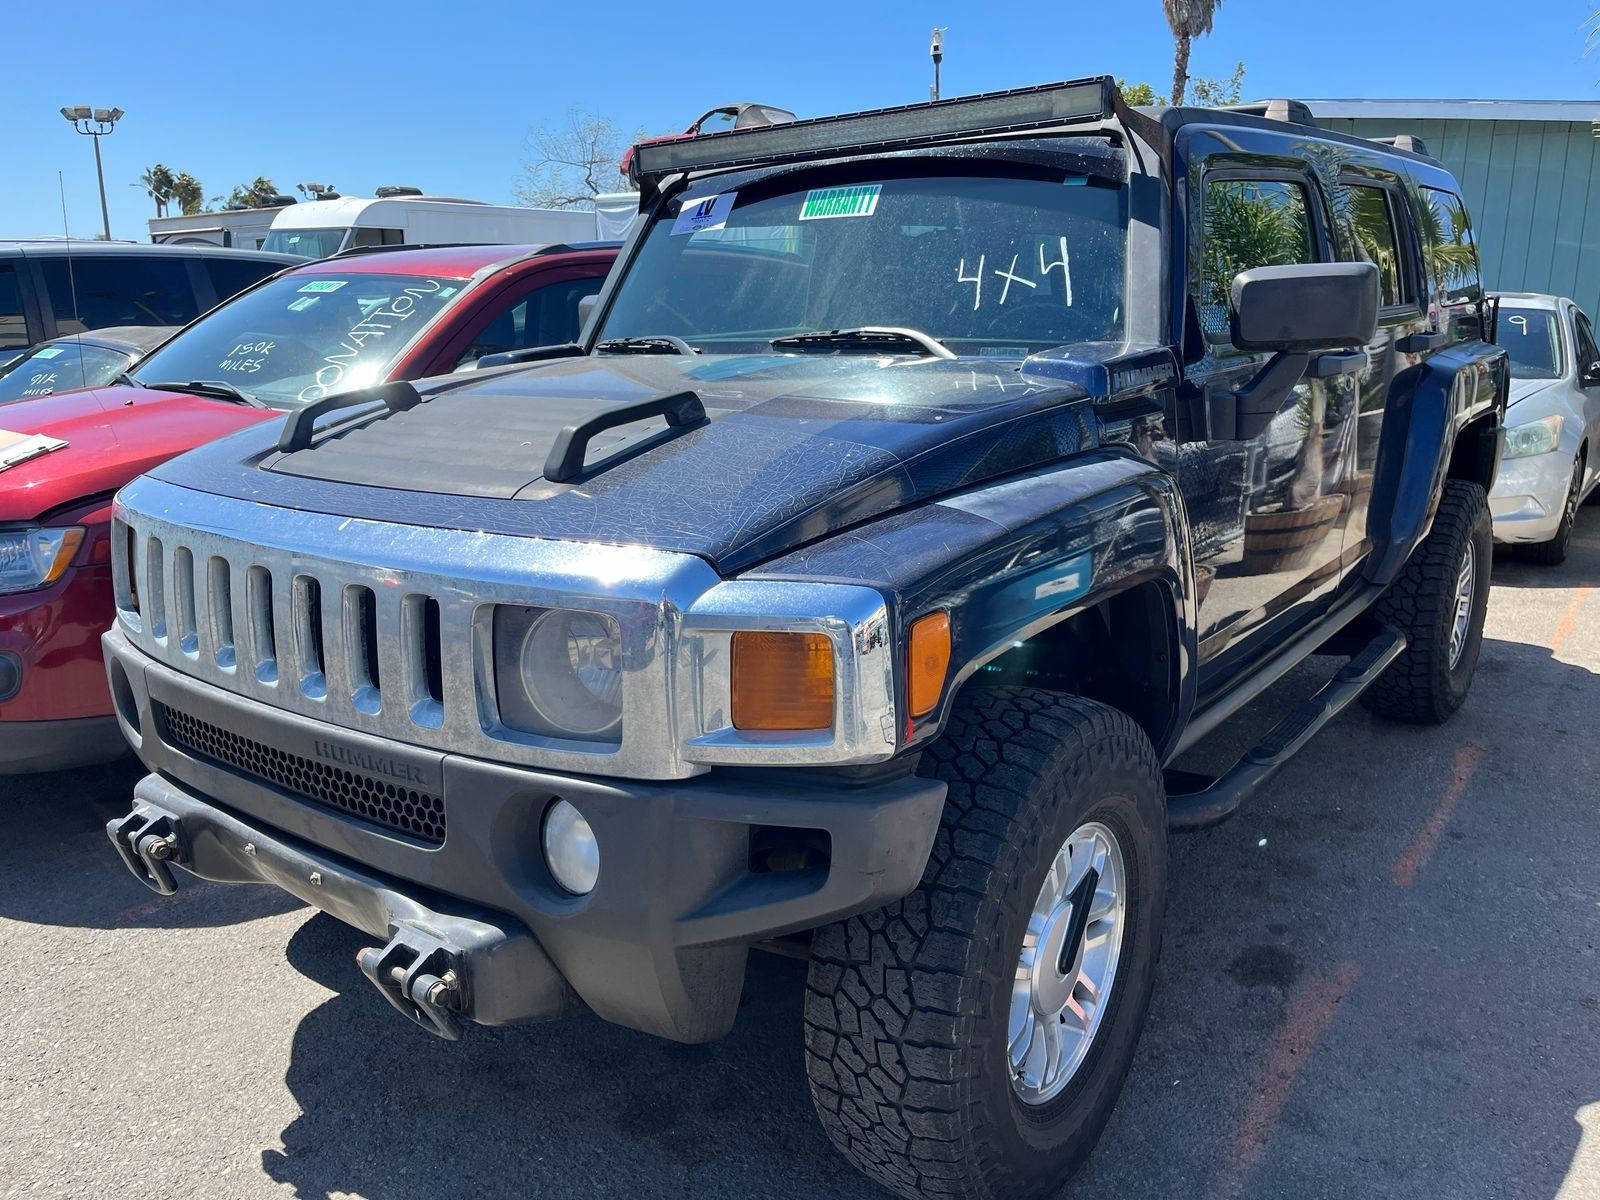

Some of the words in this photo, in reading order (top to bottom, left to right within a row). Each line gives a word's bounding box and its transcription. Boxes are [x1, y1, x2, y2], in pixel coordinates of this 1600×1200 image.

[803, 186, 879, 218] WARRANTY
[1508, 315, 1527, 336] 9
[297, 279, 441, 403] DONATION
[218, 358, 265, 373] MILES
[1113, 362, 1175, 390] HUMMER
[313, 740, 427, 784] HUMMER
